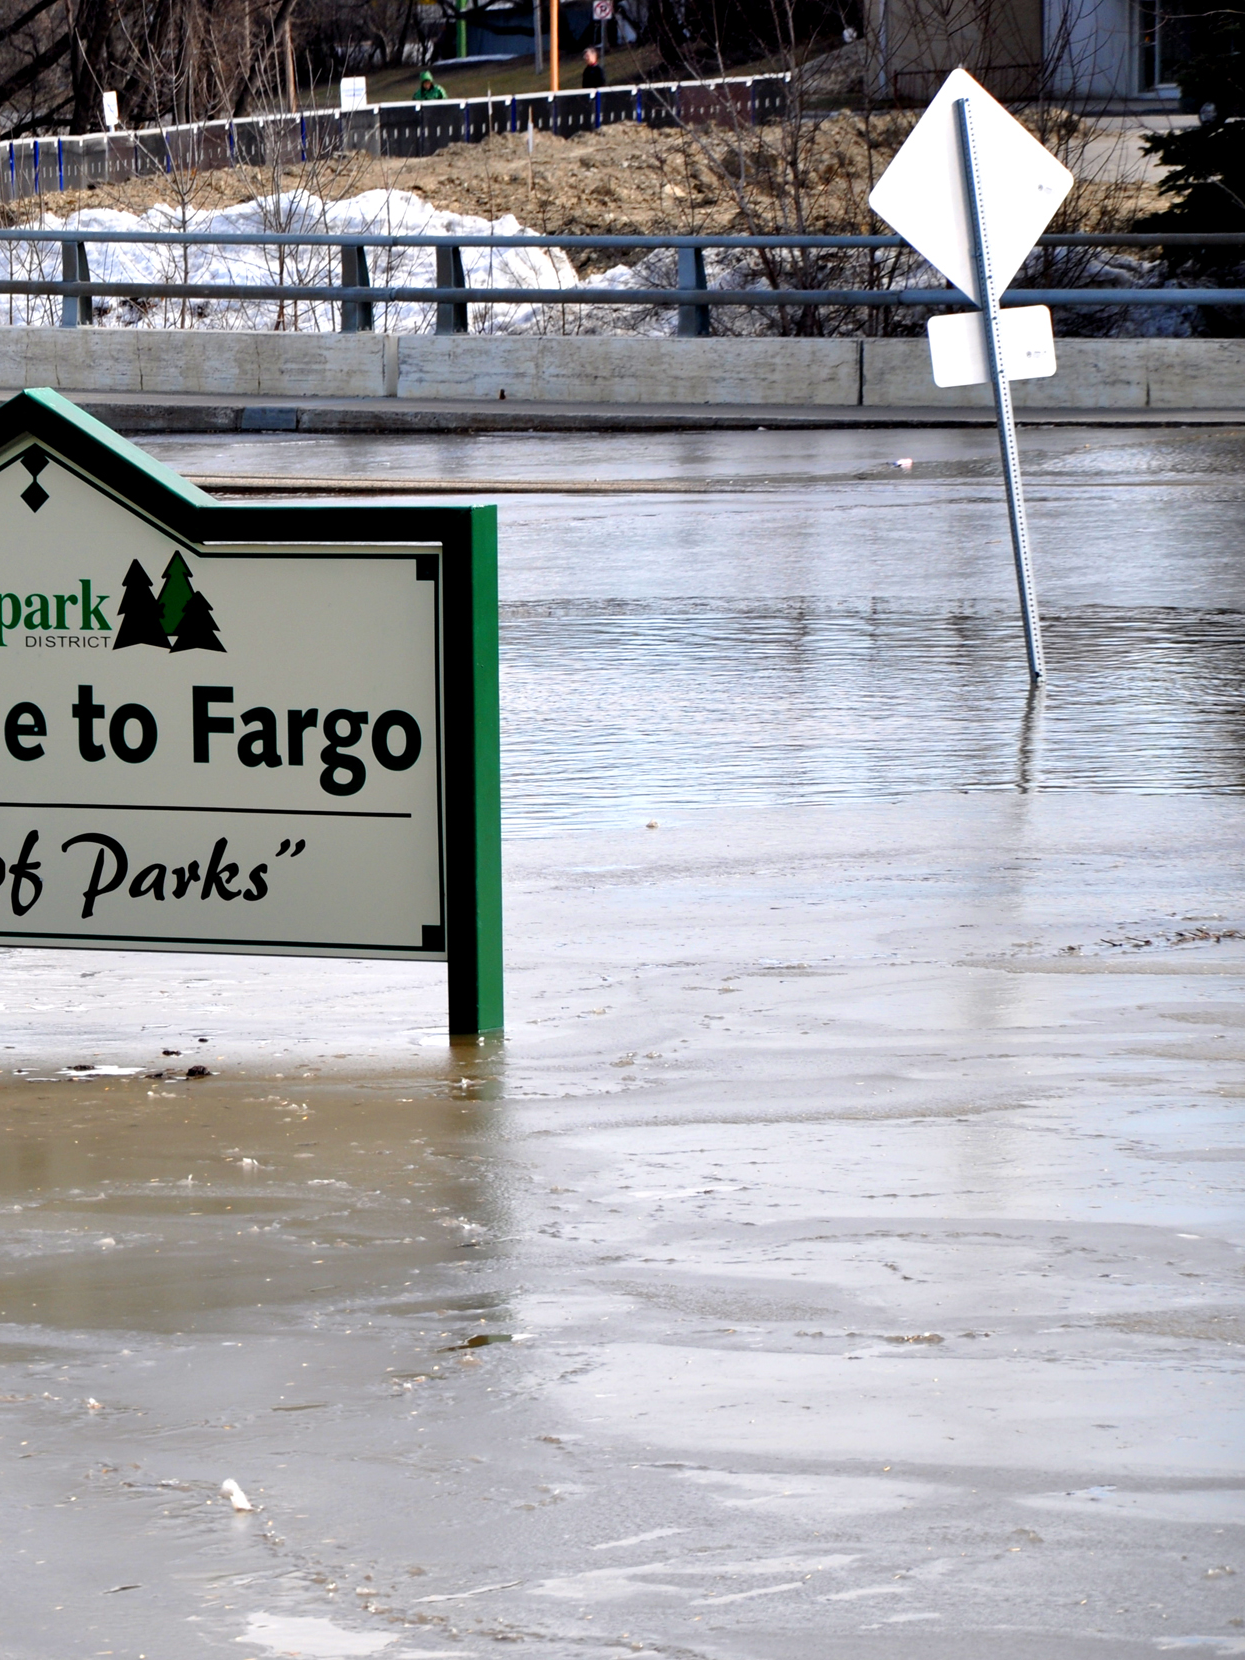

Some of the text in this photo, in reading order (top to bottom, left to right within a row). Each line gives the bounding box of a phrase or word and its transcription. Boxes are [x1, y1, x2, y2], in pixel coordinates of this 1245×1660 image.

[25, 635, 111, 648] DISTRICT
[72, 685, 158, 764] to
[192, 686, 422, 797] Fargo
[61, 832, 306, 920] Parks”
